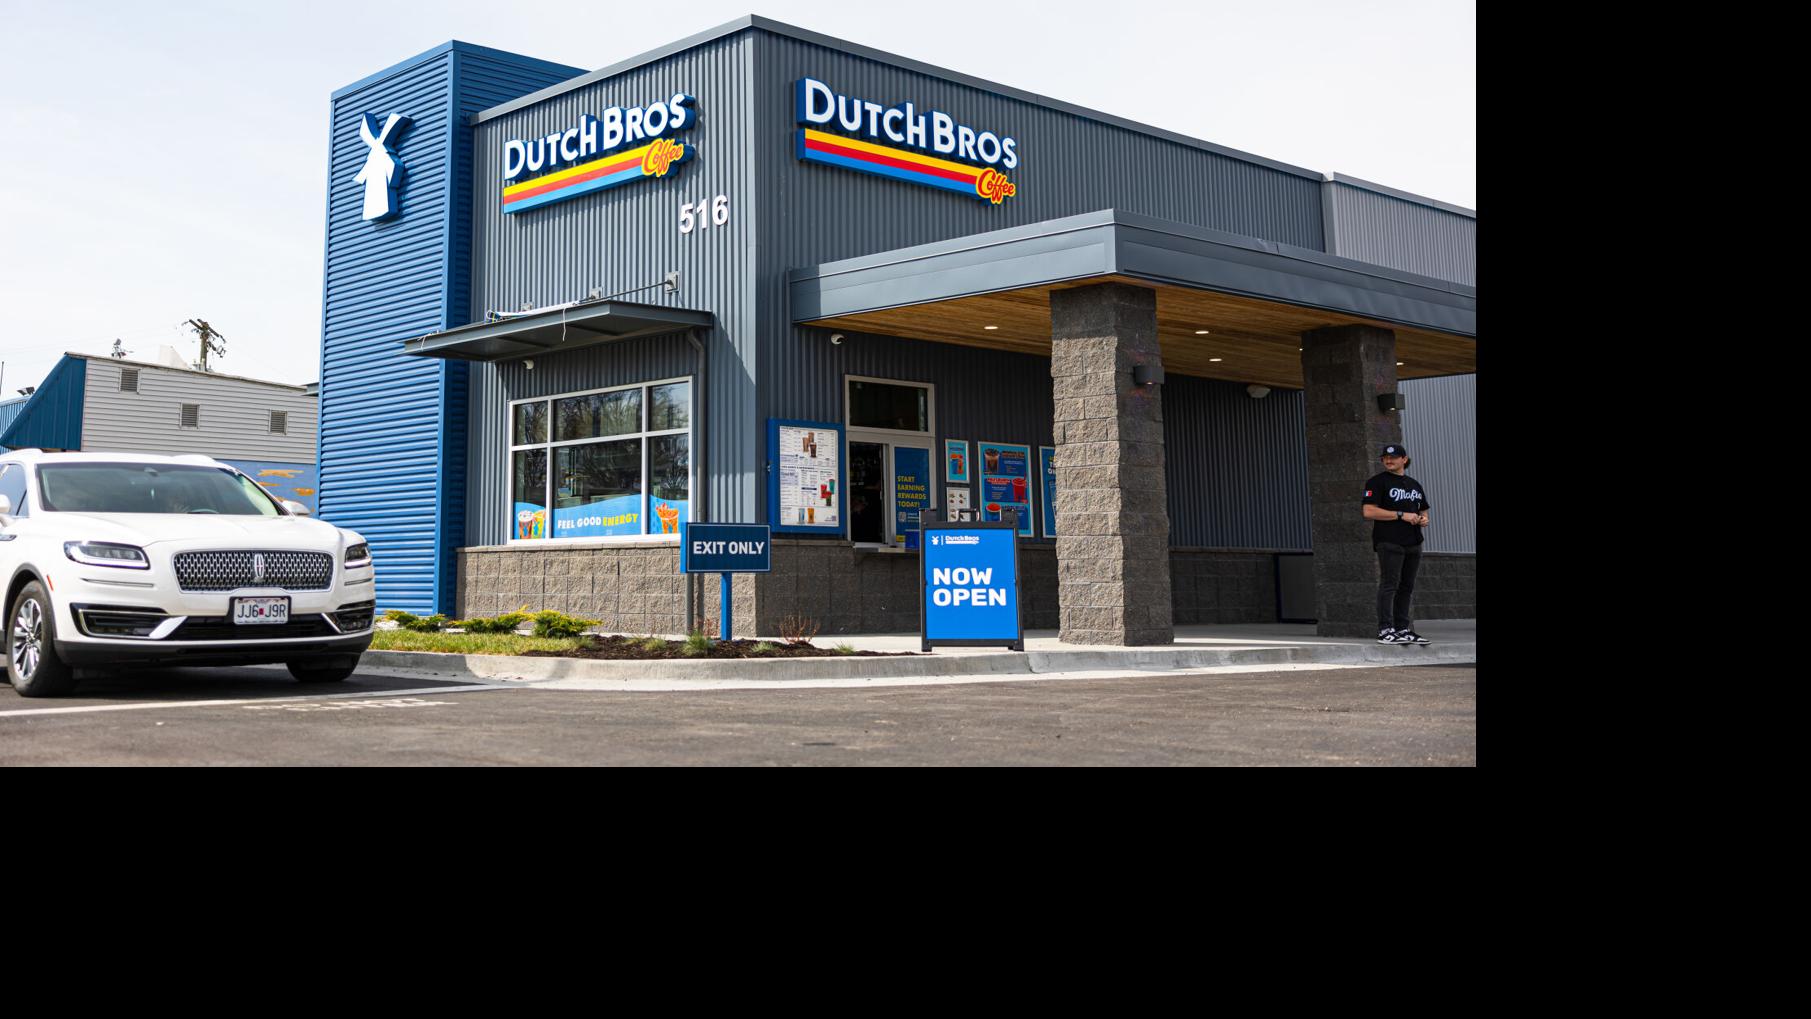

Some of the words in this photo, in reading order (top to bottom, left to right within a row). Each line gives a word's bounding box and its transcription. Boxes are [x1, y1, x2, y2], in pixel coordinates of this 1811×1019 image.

[804, 77, 926, 149] DUTCH
[932, 110, 1018, 169] BROS
[504, 113, 597, 180] DUTCH
[603, 93, 686, 150] BROS
[642, 138, 684, 176] Coffee
[977, 168, 1016, 203] Coffee
[679, 194, 729, 233] 516
[897, 475, 915, 483] START
[897, 492, 927, 500] REWARDS
[557, 519, 575, 530] FEEL
[577, 516, 601, 528] GOOD
[602, 513, 639, 527] ENERGY
[693, 541, 726, 555] EXIT
[728, 541, 765, 555] ONLY
[933, 567, 993, 586] NOW
[933, 588, 1007, 607] OPEN
[237, 604, 259, 618] JJ6
[265, 604, 286, 618] J9R
